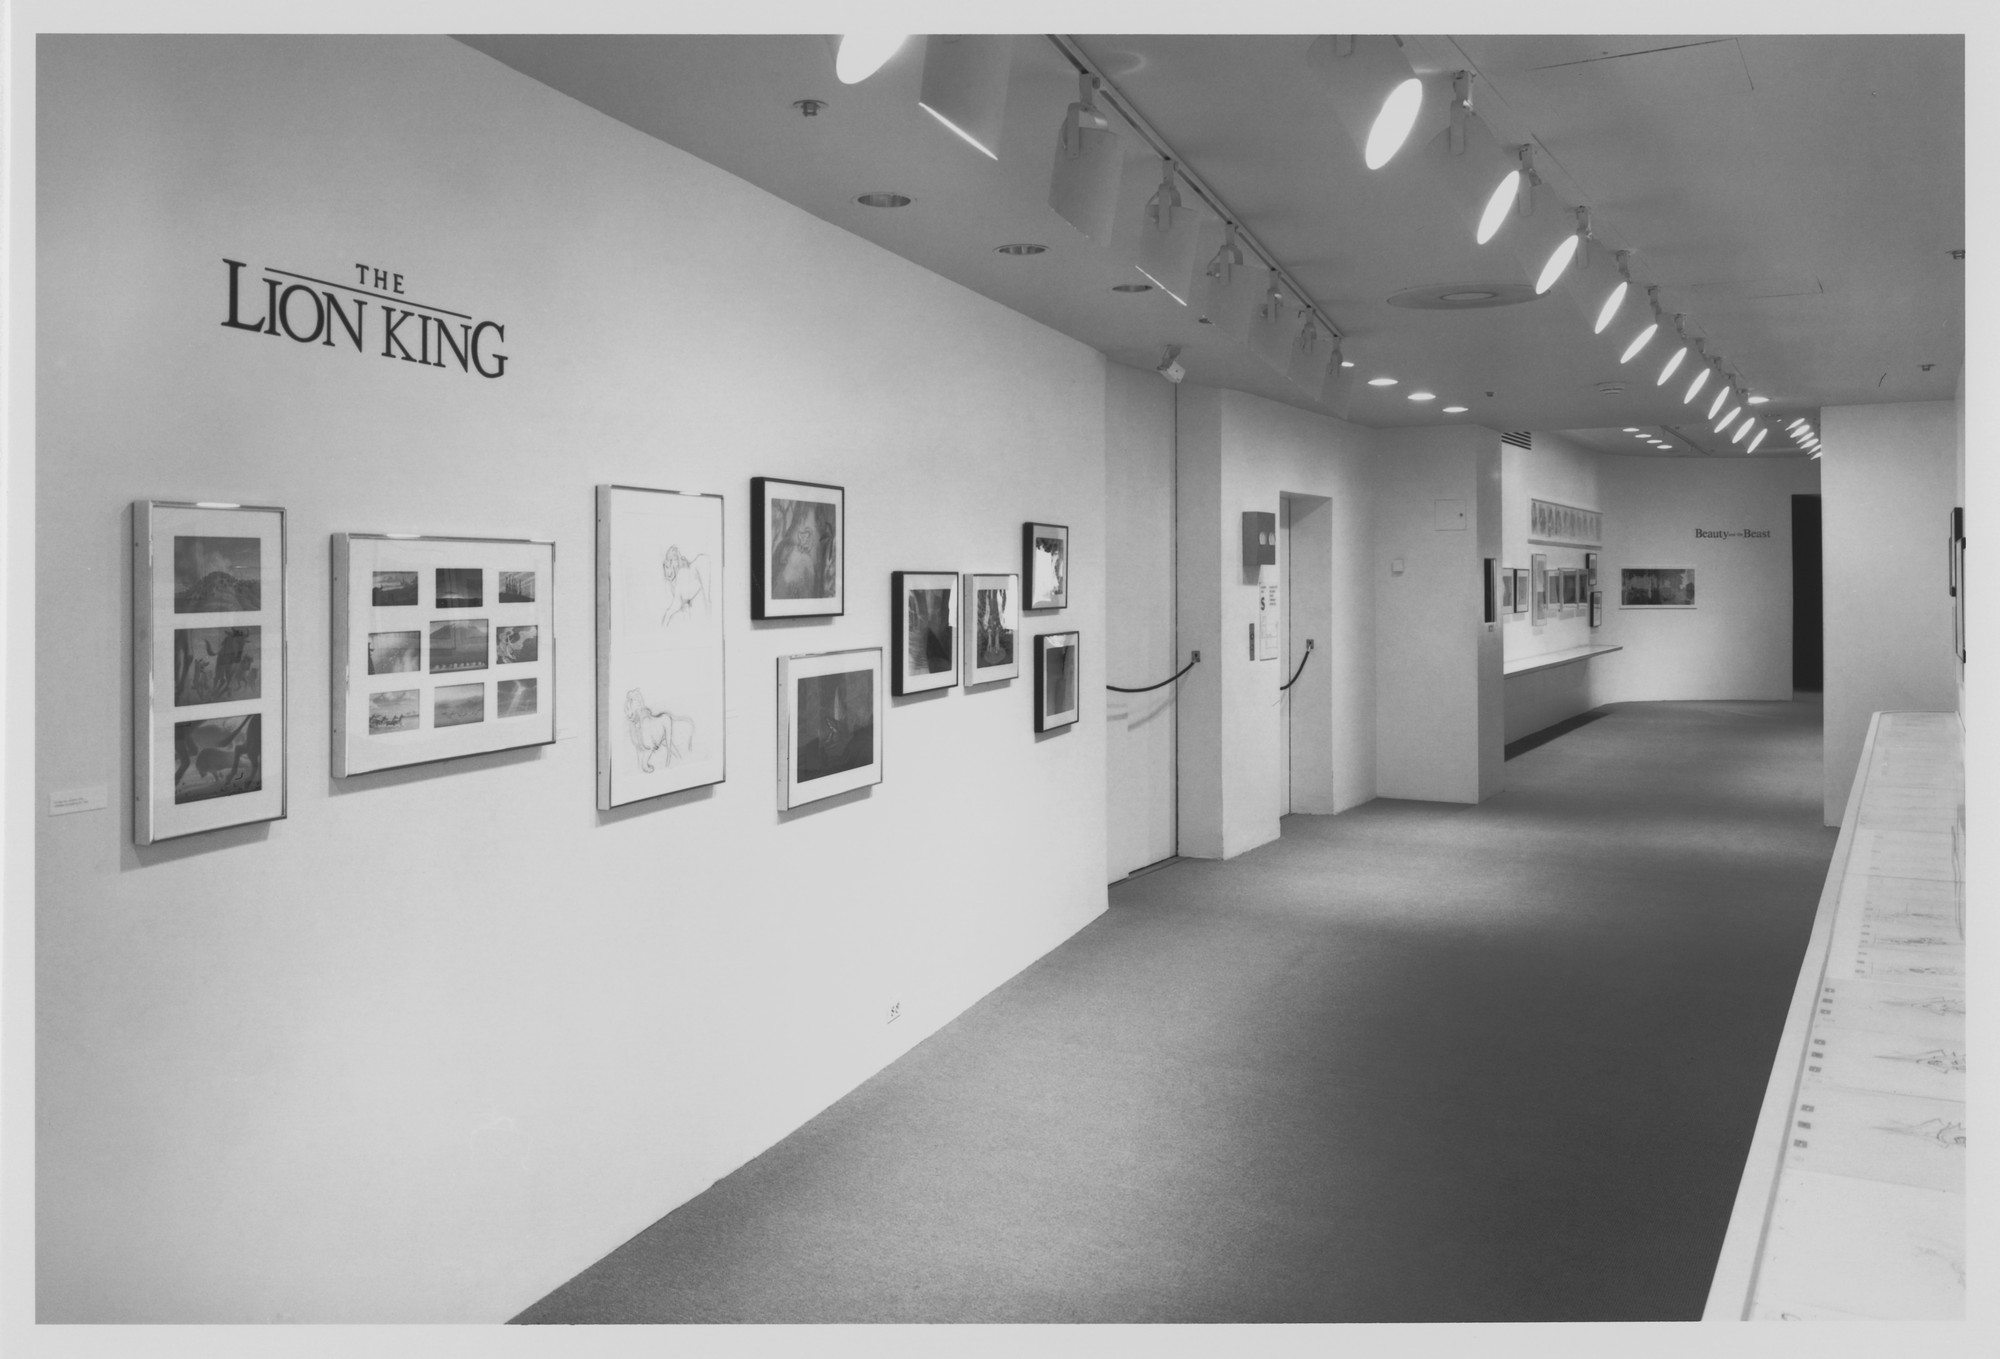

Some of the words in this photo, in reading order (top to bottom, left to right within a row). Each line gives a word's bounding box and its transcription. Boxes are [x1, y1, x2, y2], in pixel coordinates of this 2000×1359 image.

[355, 263, 405, 295] THE
[221, 258, 368, 353] LION
[381, 305, 509, 379] KING
[1695, 528, 1729, 540] Beauty
[1743, 528, 1771, 538] Beast
